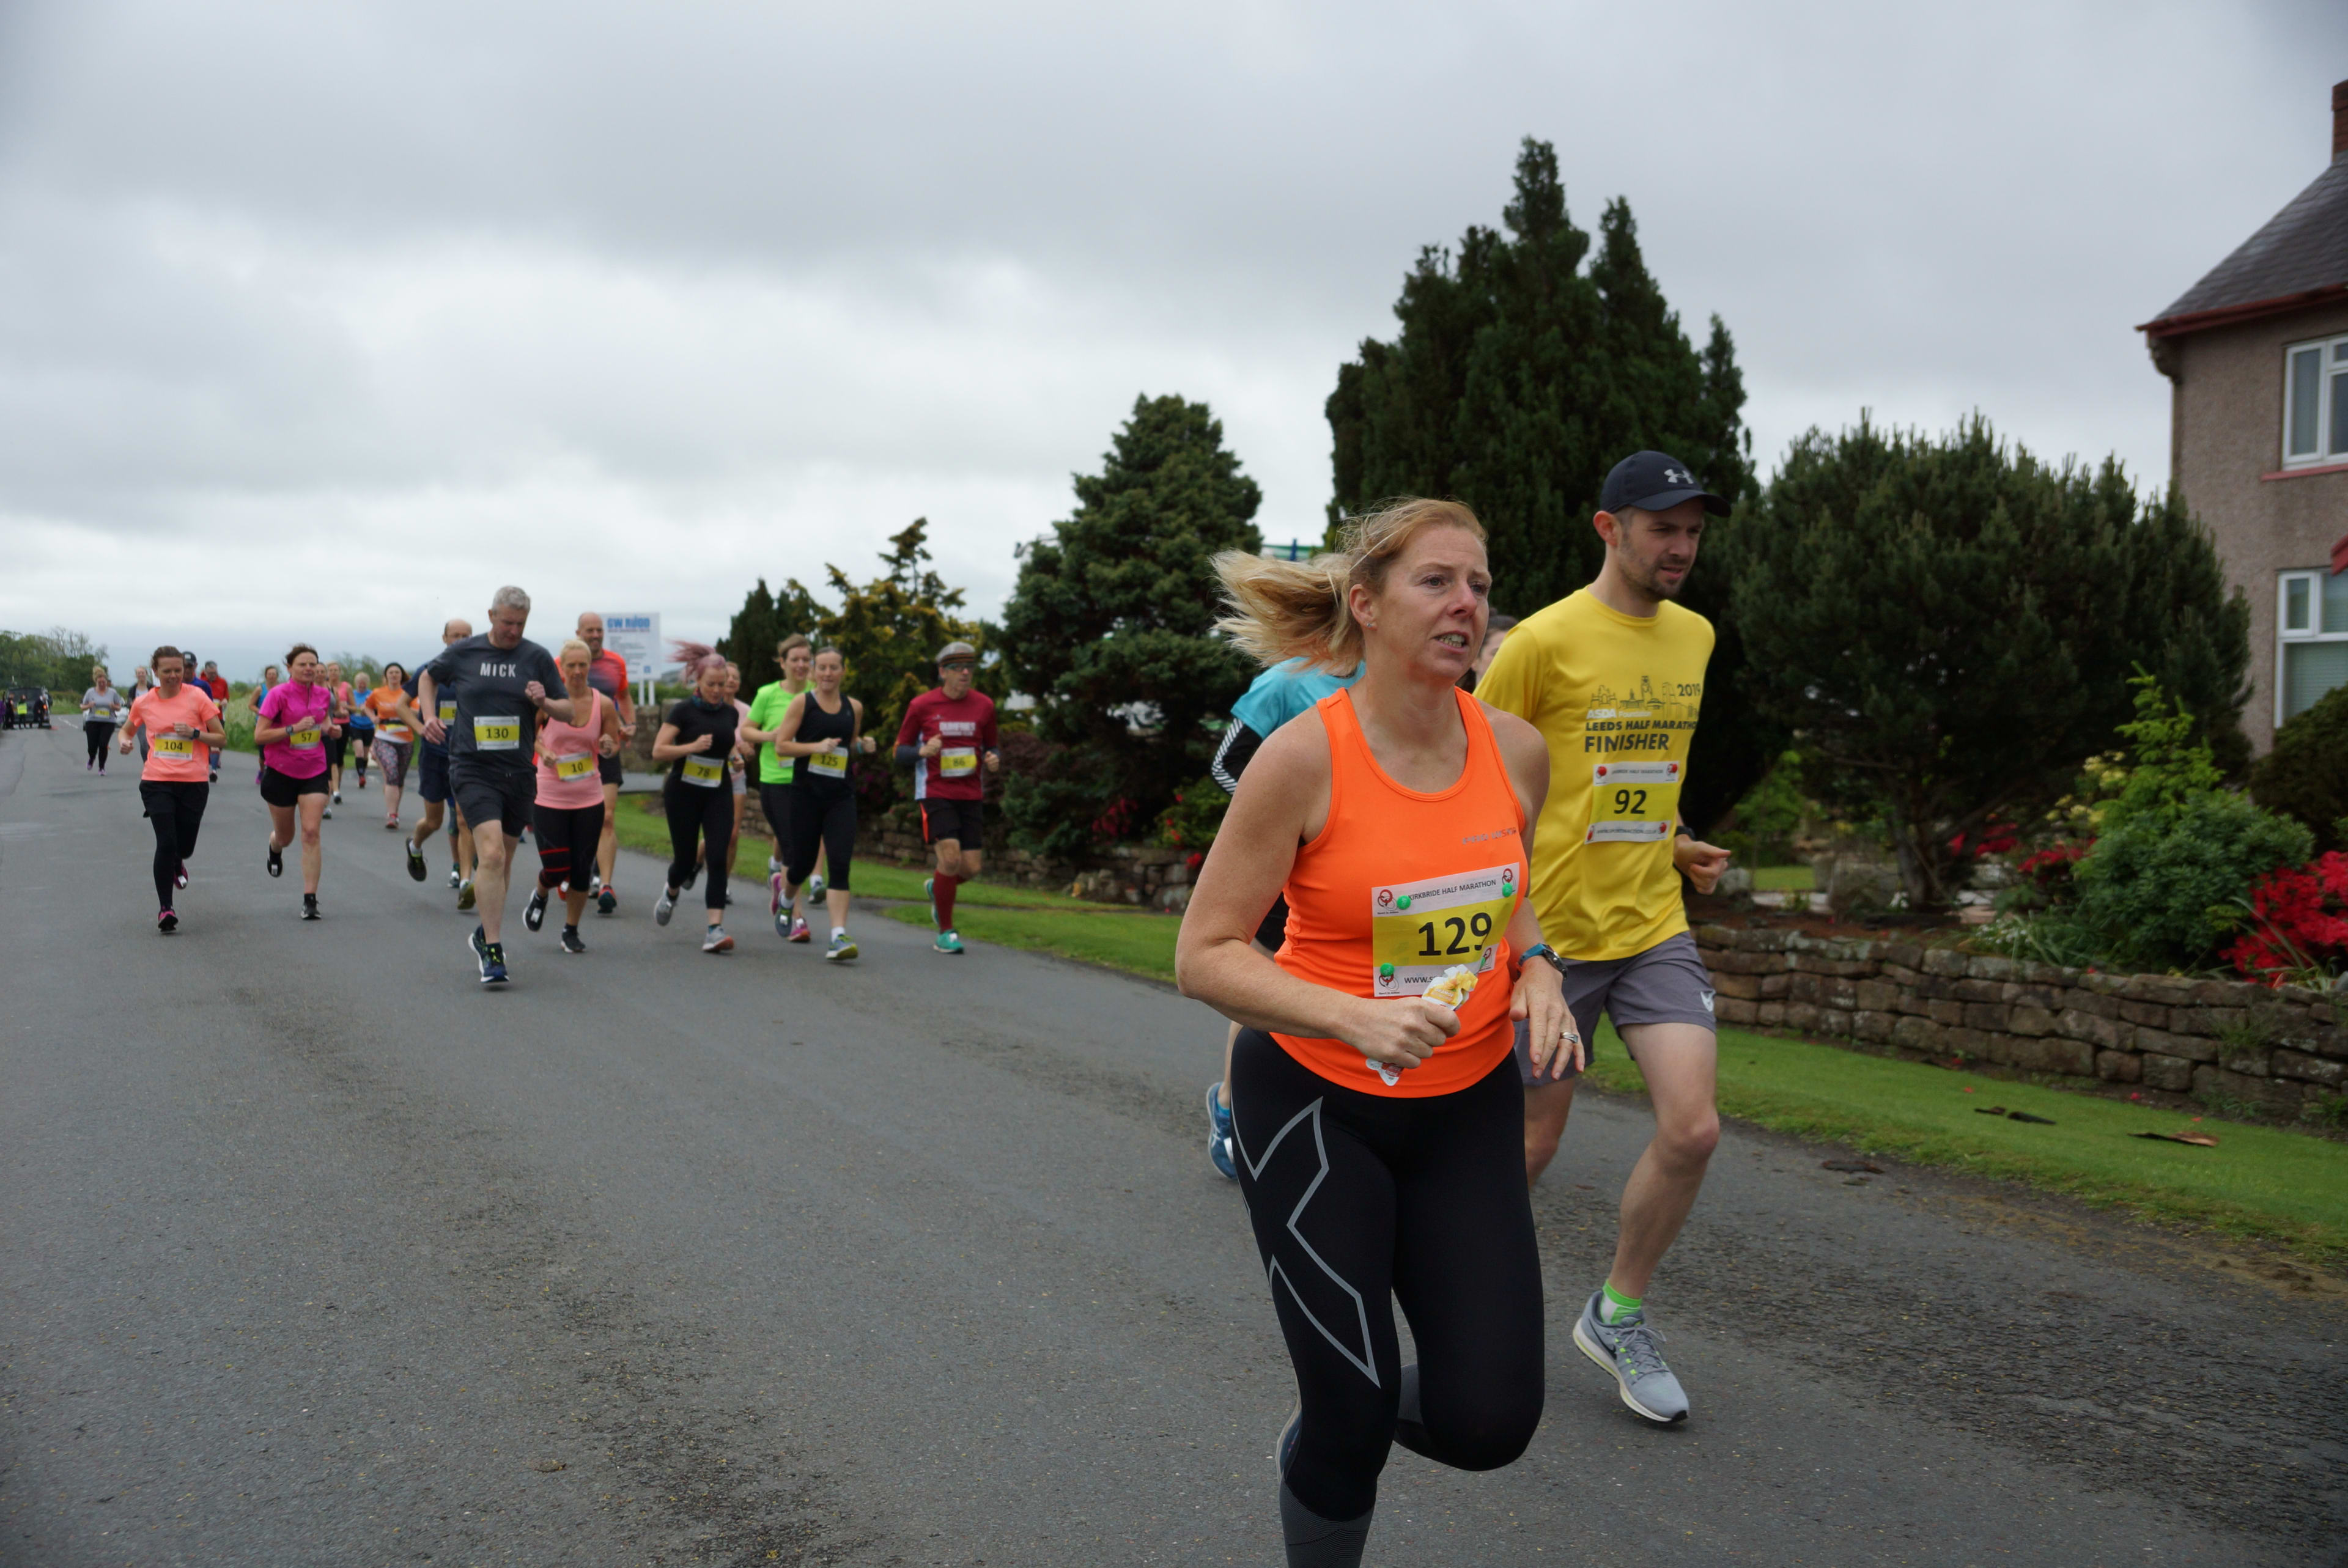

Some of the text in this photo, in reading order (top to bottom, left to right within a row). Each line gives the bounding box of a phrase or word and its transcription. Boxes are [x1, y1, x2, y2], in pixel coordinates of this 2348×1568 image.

[480, 662, 516, 677] MICK
[1677, 683, 1700, 696] 2019
[1586, 709, 1617, 719] ASDA
[1586, 720, 1698, 731] LEEDS HALF MARATHO
[301, 732, 312, 742] 57
[485, 728, 509, 738] 130
[164, 742, 183, 751] 104
[1584, 734, 1669, 753] FINISHER
[821, 754, 838, 767] 125
[572, 762, 583, 773] 10
[698, 767, 711, 778] 78
[1614, 789, 1647, 814] 92
[1441, 886, 1458, 894] HALF
[1459, 879, 1497, 892] MARATHON
[1419, 912, 1492, 956] 129
